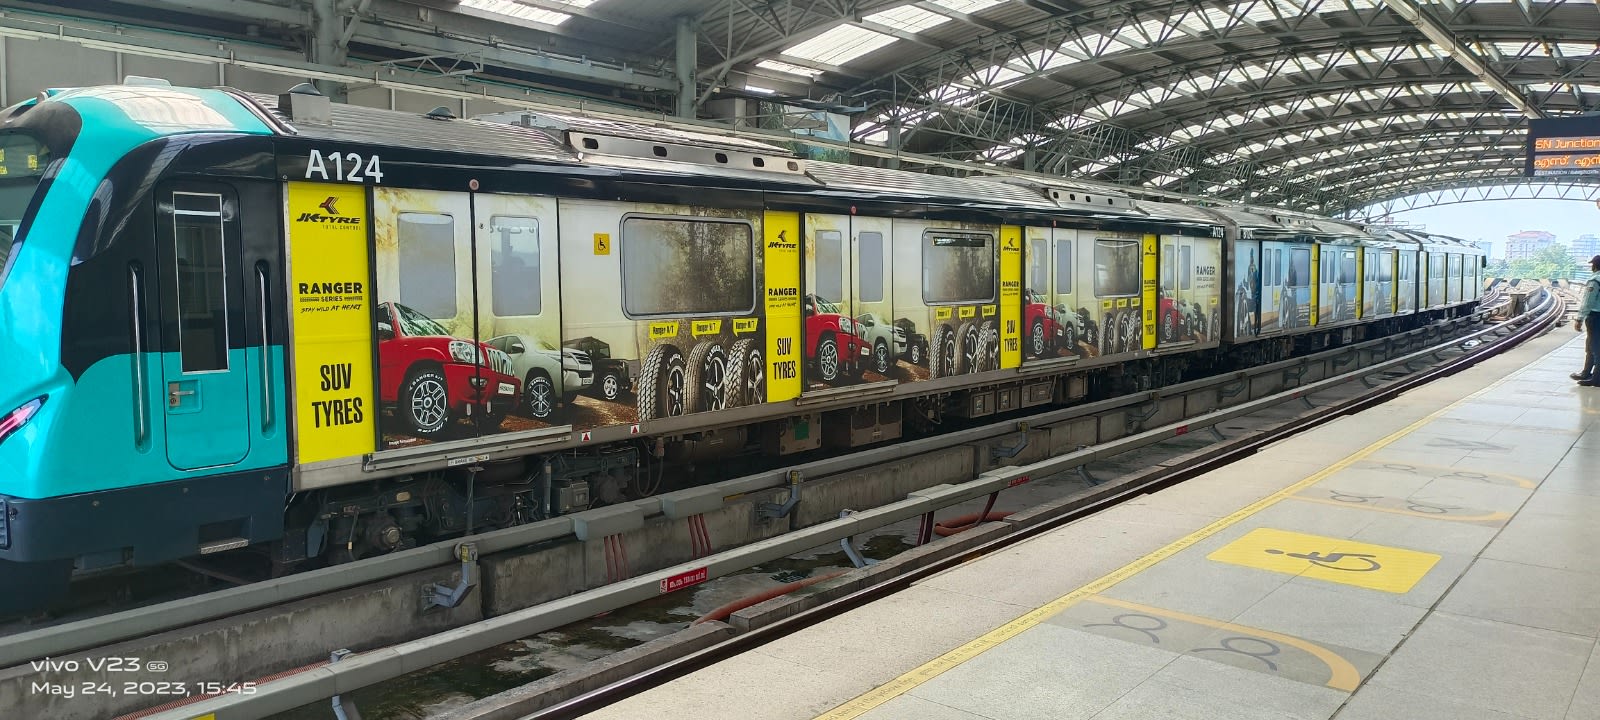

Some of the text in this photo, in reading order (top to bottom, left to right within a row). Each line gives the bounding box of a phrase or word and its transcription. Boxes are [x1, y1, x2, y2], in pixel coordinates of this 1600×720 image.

[1535, 138, 1600, 149] SN Junction
[305, 149, 384, 184] A124
[1212, 226, 1224, 238] A124
[1196, 265, 1216, 276] RANGER
[298, 282, 363, 295] RANGER
[768, 287, 797, 296] RANGER
[1006, 319, 1016, 334] SUV
[777, 337, 792, 356] SUV
[1004, 337, 1018, 353] TYRES
[320, 363, 352, 392] SUV
[772, 360, 796, 380] TYRES
[311, 396, 364, 429] TYRES
